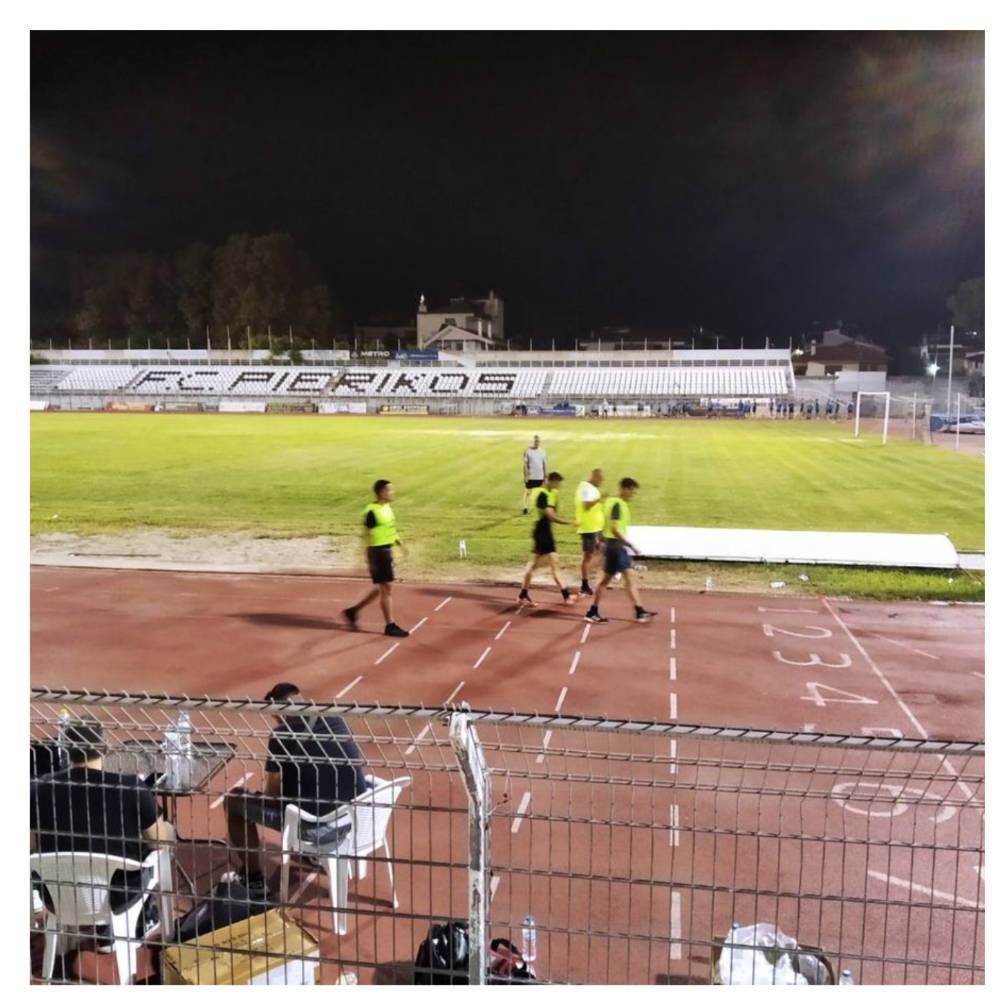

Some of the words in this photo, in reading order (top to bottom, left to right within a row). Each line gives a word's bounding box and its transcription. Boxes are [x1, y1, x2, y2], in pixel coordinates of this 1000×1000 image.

[133, 370, 218, 391] F.C.
[227, 371, 518, 393] PIERIKOS
[763, 623, 833, 639] 2
[773, 650, 852, 669] 3
[799, 681, 879, 707] 4
